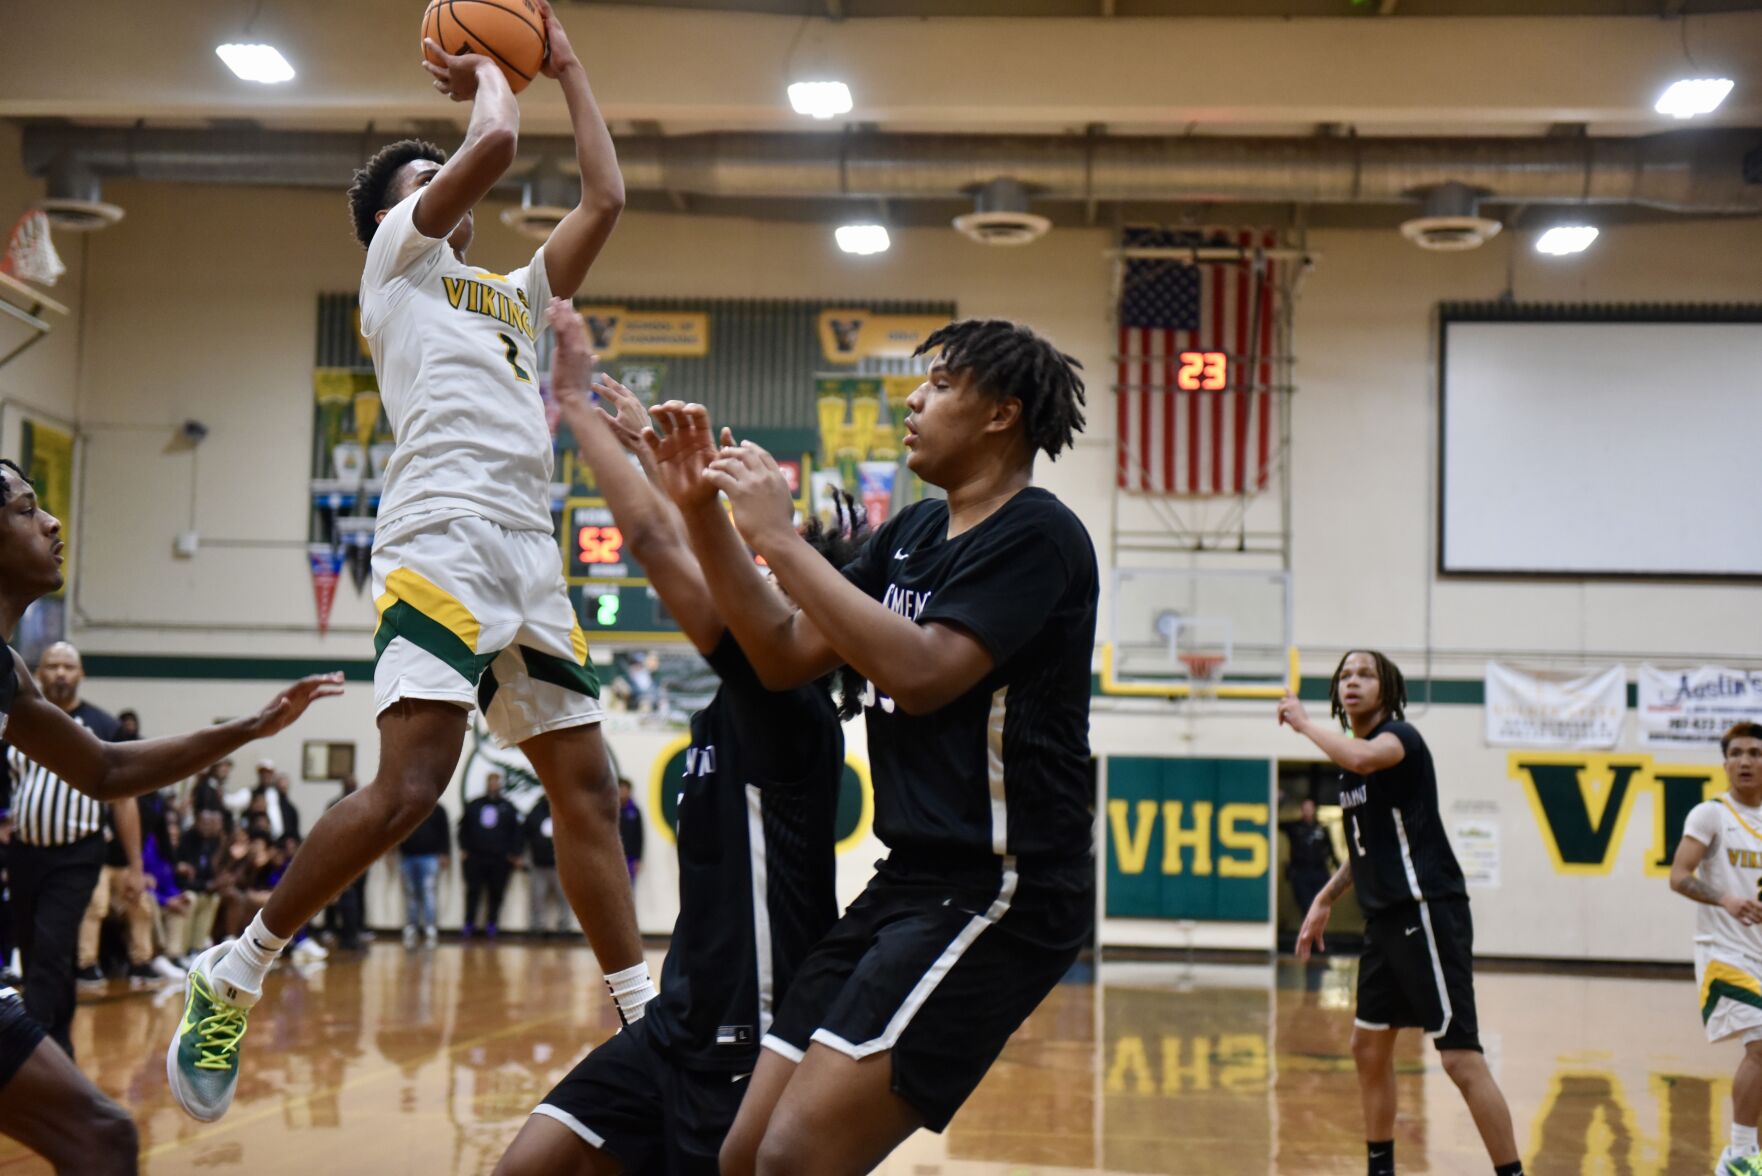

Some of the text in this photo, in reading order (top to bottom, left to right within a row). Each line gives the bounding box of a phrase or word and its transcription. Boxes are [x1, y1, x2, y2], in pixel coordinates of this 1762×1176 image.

[1178, 351, 1227, 391] 23
[578, 526, 623, 563] 52
[597, 594, 619, 626] 2
[1108, 799, 1269, 877] VHS
